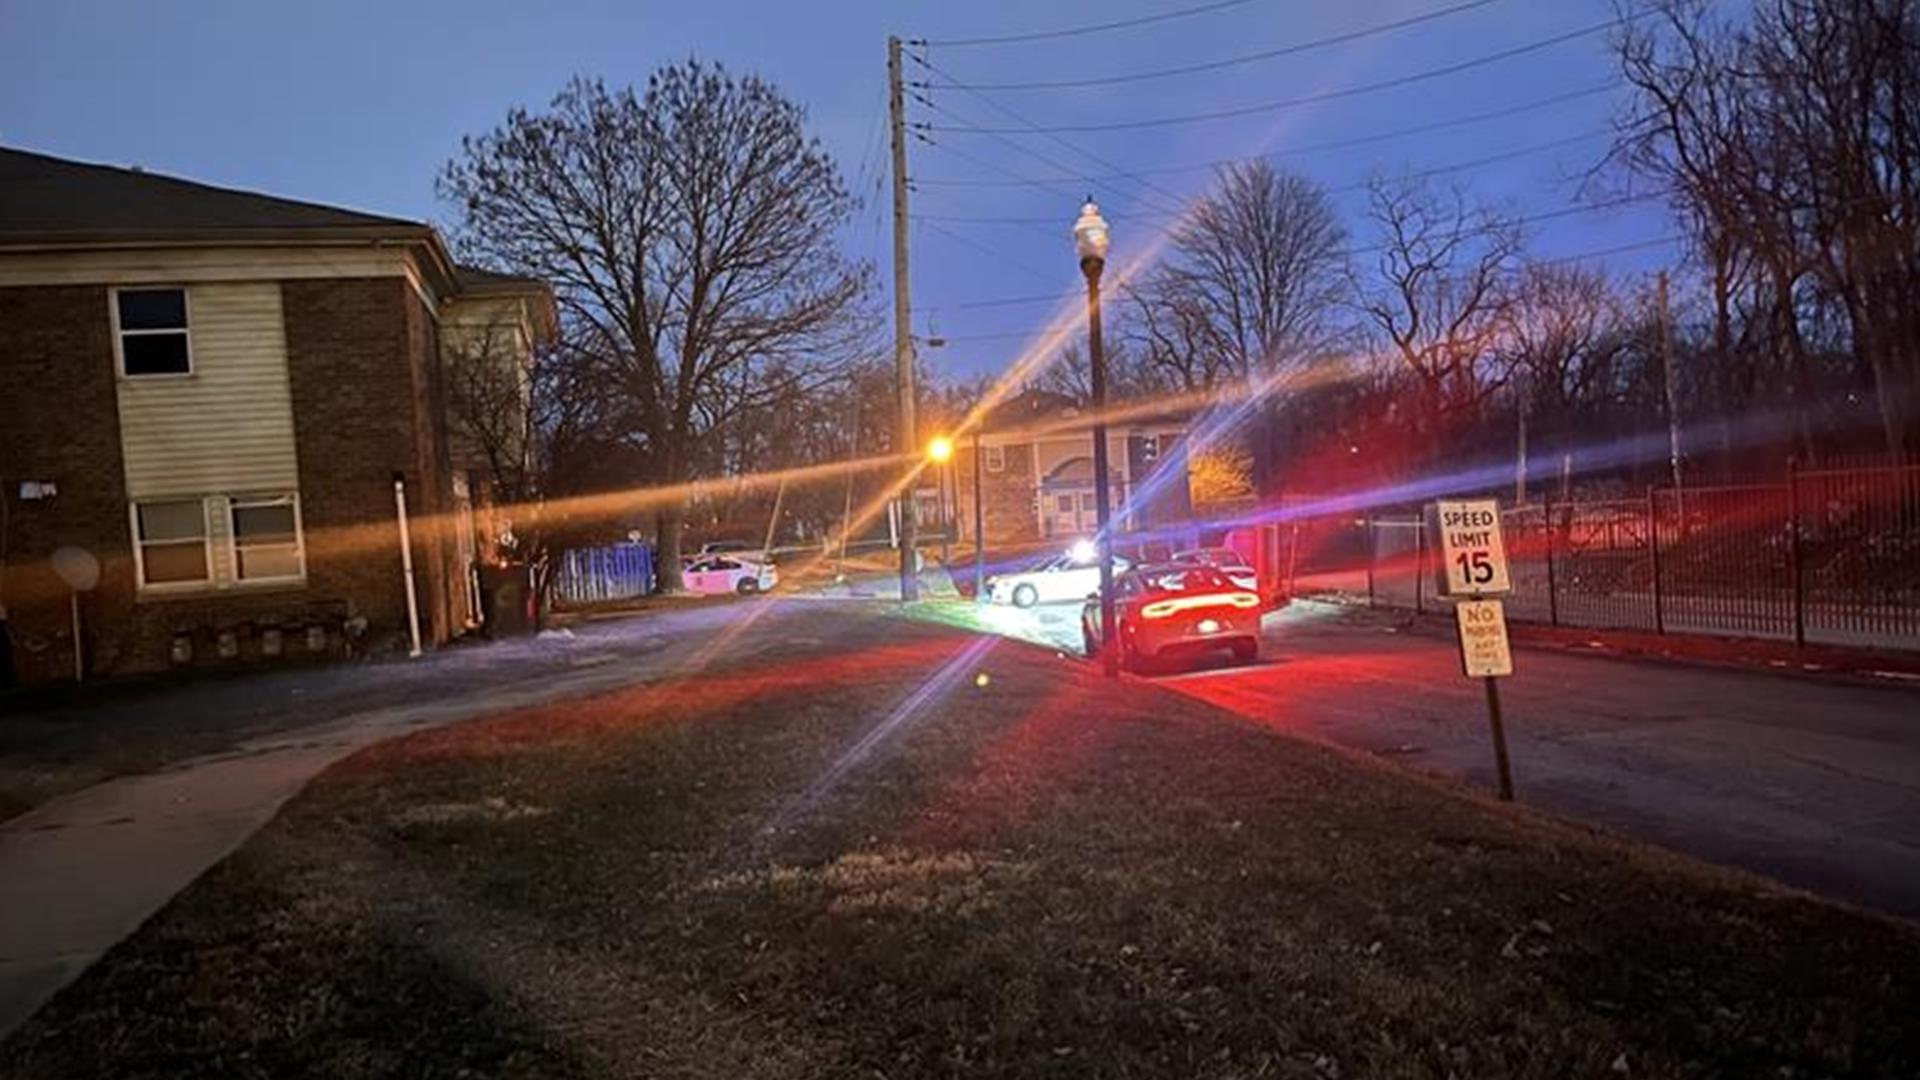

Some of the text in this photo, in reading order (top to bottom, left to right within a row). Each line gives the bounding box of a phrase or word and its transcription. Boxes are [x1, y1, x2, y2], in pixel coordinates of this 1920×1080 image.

[1444, 511, 1493, 526] SPEED
[1451, 532, 1490, 547] LIMIT
[1456, 552, 1493, 584] 15
[1467, 607, 1494, 622] NO
